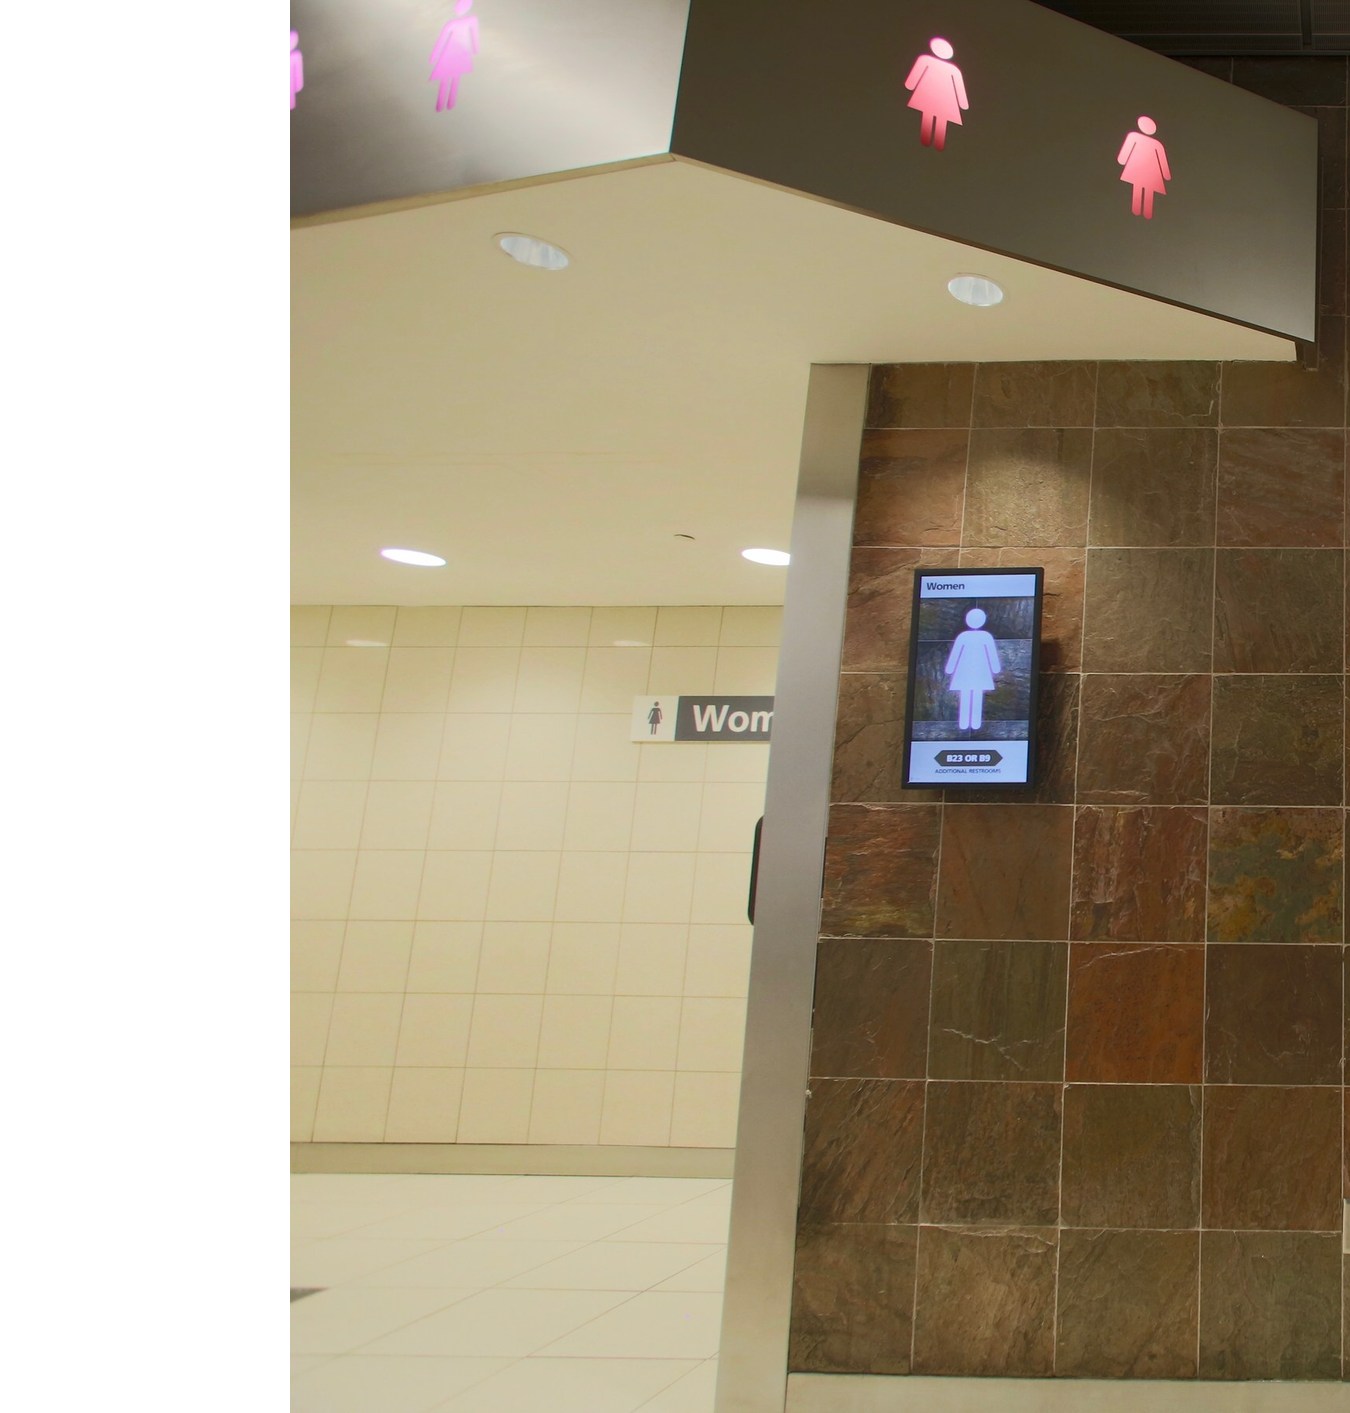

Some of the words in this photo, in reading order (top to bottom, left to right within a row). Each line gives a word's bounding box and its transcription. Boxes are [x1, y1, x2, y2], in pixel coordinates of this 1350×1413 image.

[926, 582, 966, 591] Women
[946, 754, 963, 763] B23
[964, 754, 978, 763] OR
[979, 754, 991, 763] B9
